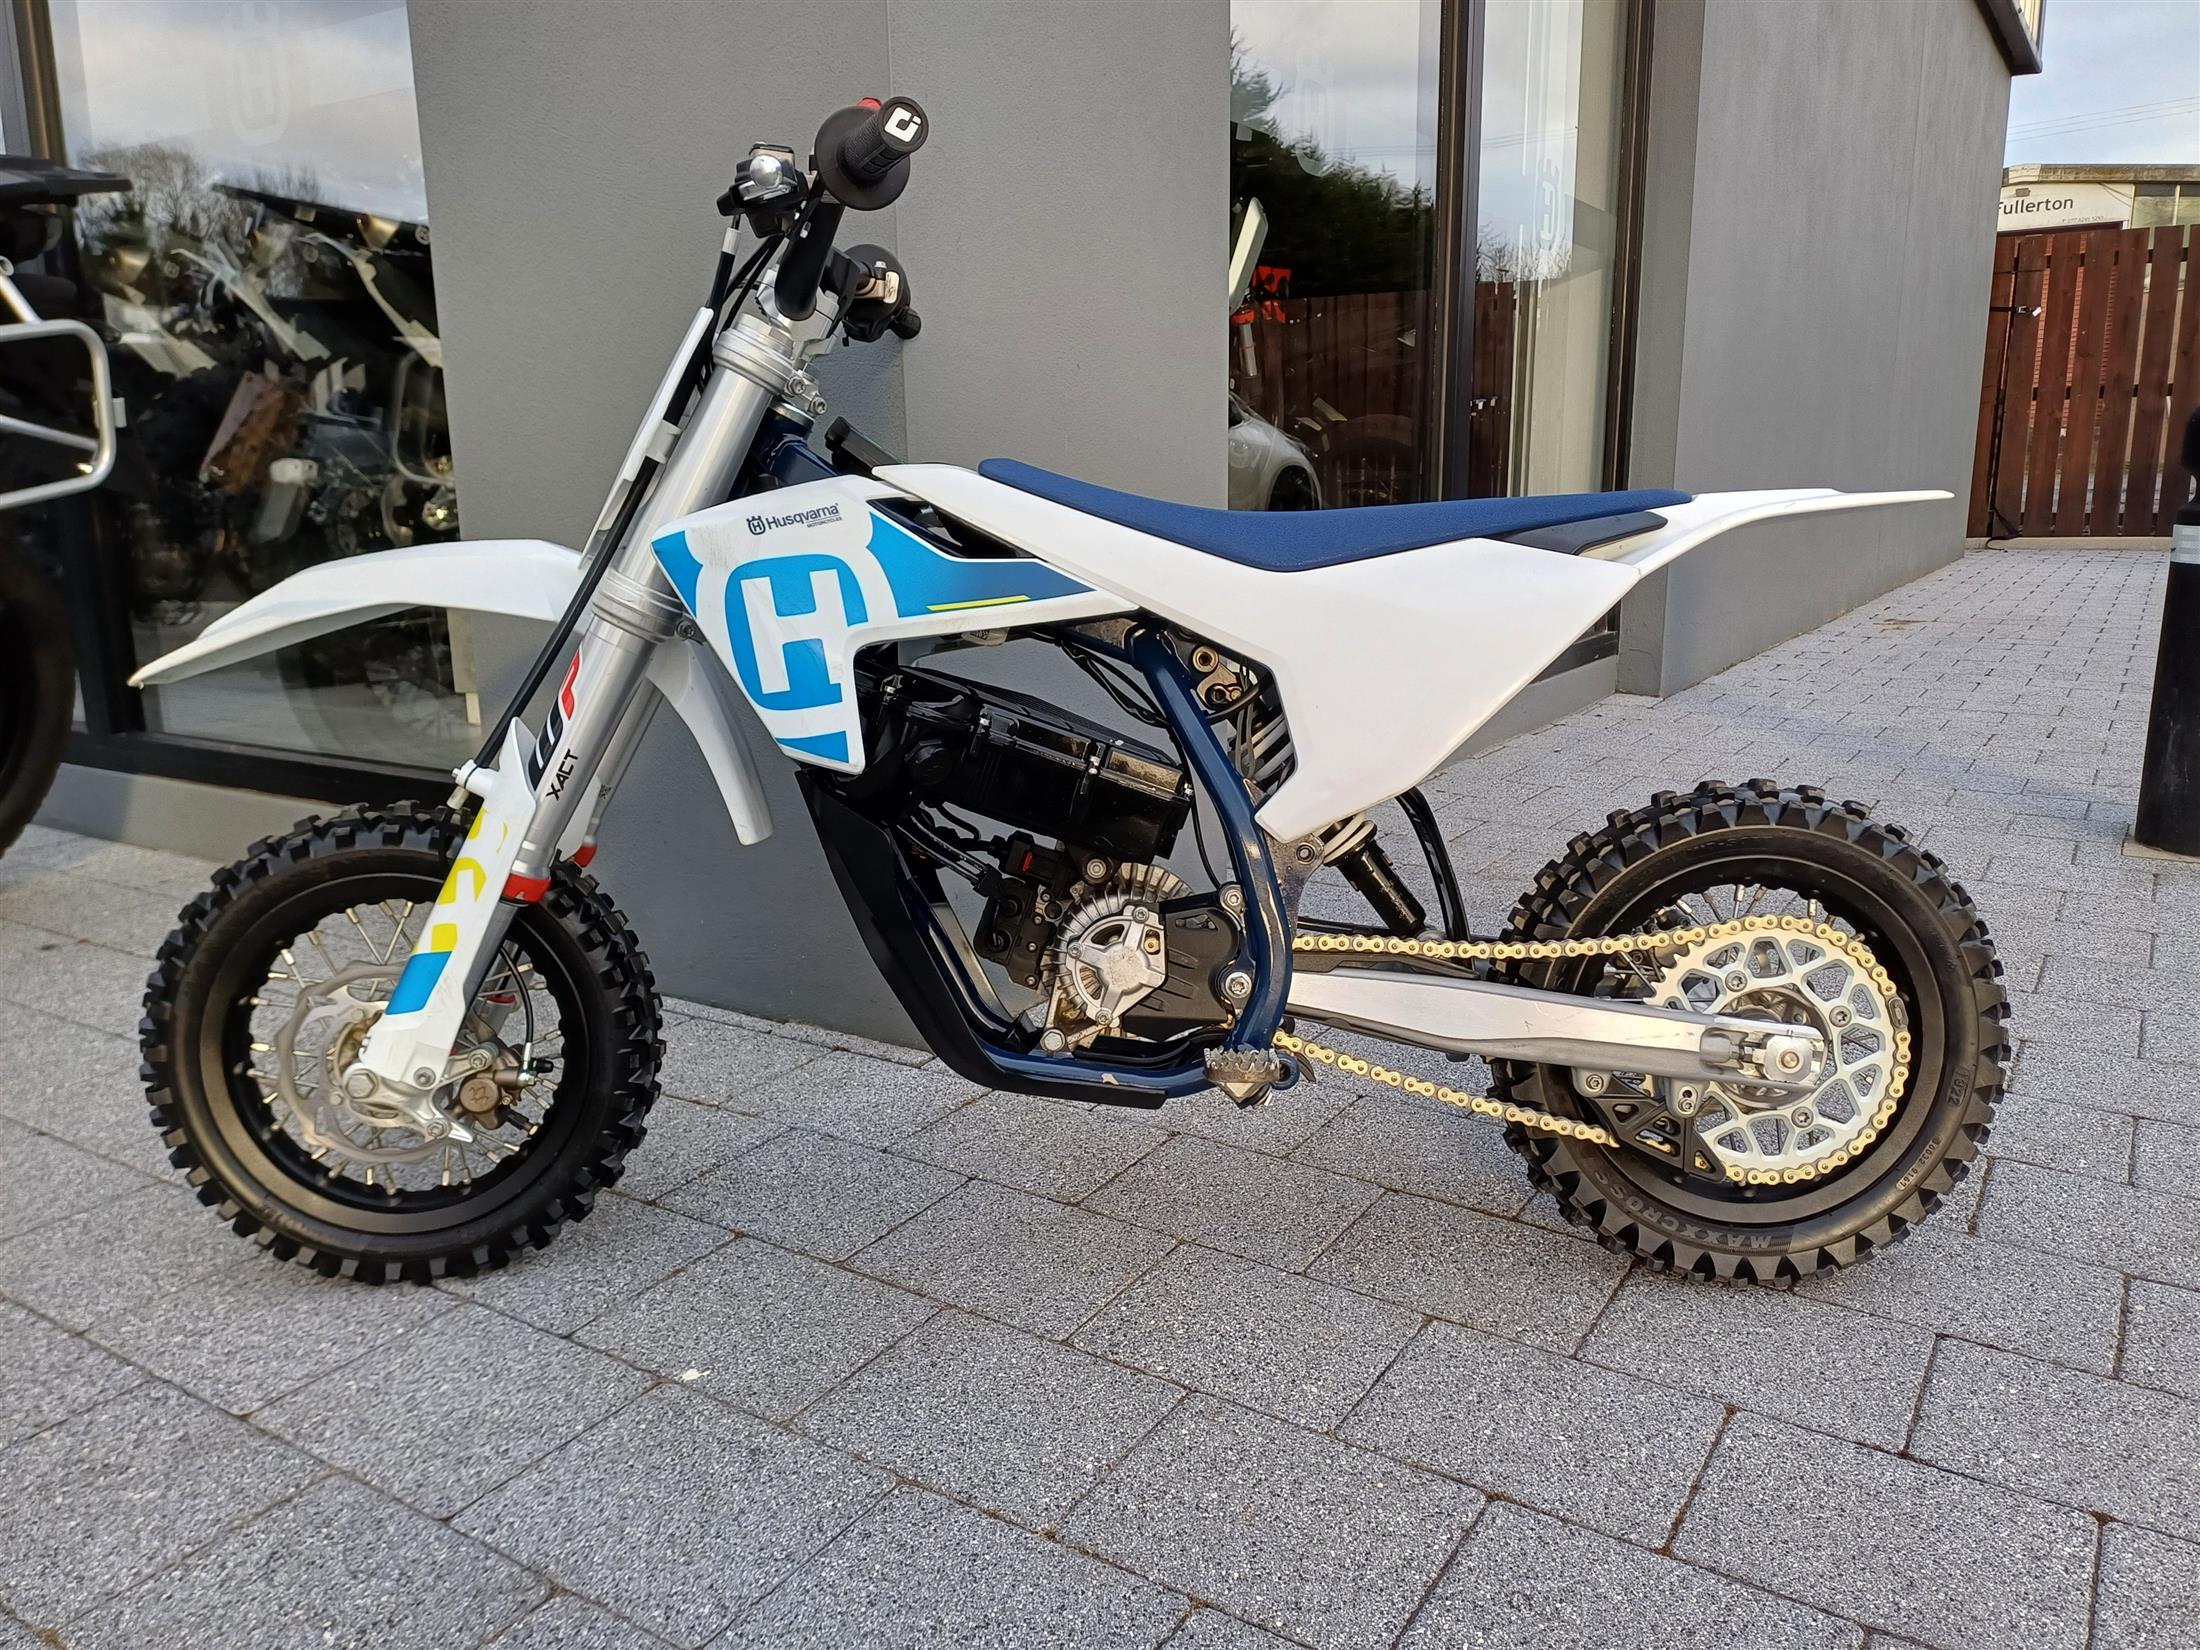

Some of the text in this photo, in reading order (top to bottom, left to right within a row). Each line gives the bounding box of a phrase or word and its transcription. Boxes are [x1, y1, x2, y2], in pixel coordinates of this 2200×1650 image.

[765, 503, 839, 530] Husqvarna
[546, 748, 579, 801] XACT
[1594, 1171, 1772, 1249] MAXXCROSS
